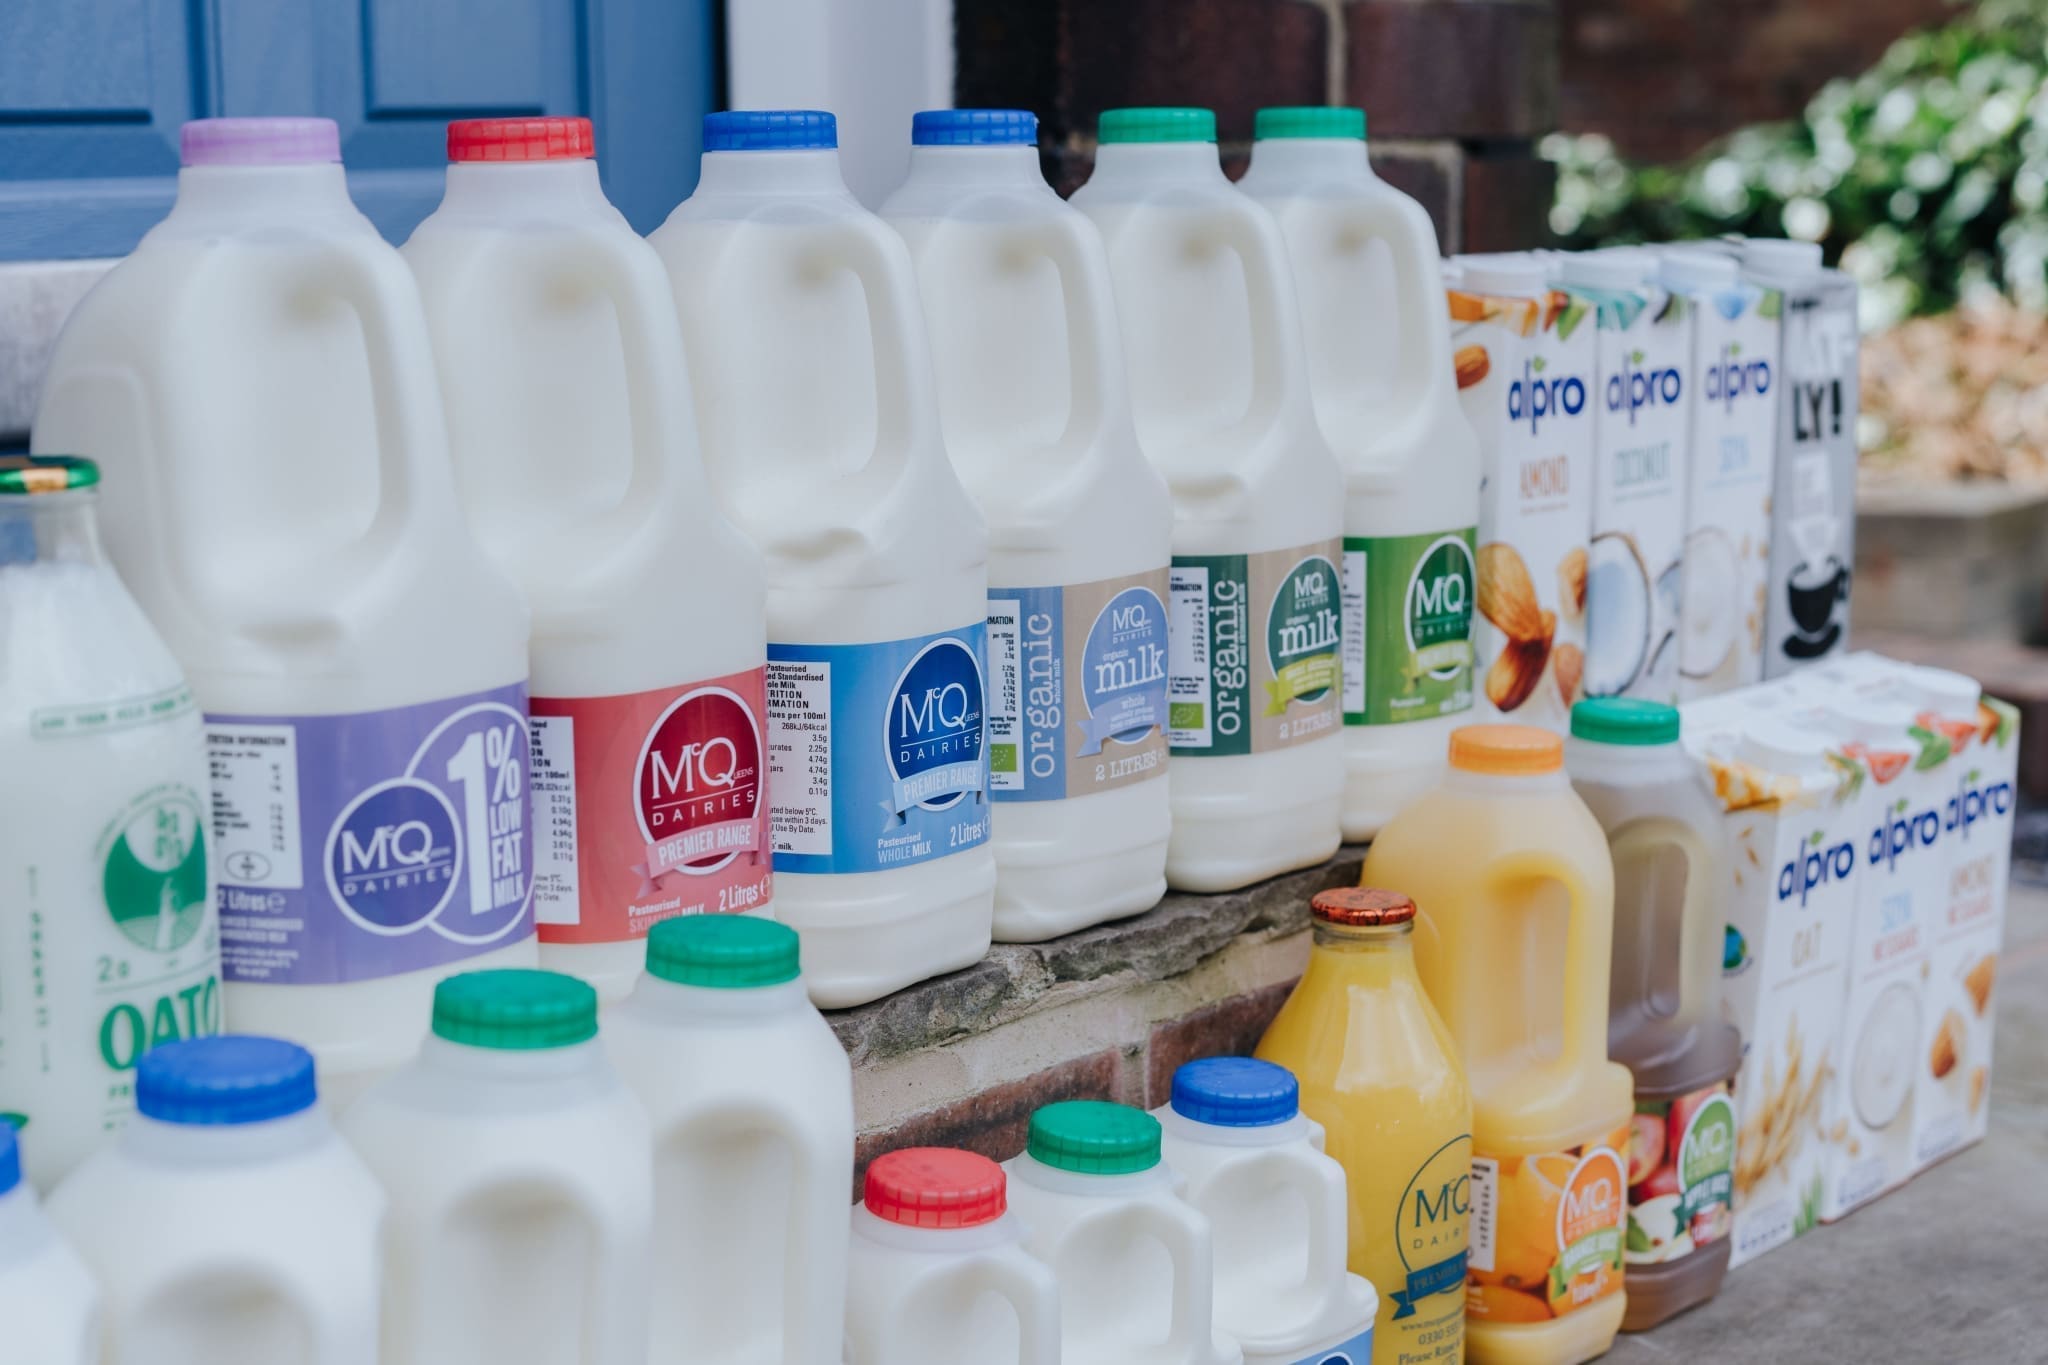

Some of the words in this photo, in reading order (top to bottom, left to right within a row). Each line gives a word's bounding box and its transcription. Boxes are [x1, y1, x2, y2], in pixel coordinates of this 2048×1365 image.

[1607, 353, 1681, 426] alpro
[1706, 345, 1770, 415] alpro
[1508, 359, 1586, 435] alpro
[1793, 379, 1842, 442] LY!
[1278, 608, 1339, 658] milk
[1095, 642, 1166, 694] milk
[1102, 648, 1129, 662] organic
[1209, 580, 1246, 735] organic
[767, 681, 778, 689] ole
[780, 681, 796, 689] Milk
[777, 672, 824, 682] Standardised
[1022, 613, 1061, 778] organic
[803, 712, 826, 720] 100ml
[808, 745, 828, 754] 2.25g
[812, 734, 828, 743] 3.5g
[901, 732, 981, 763] DAIRIES
[808, 756, 828, 764] 4.74g
[808, 767, 828, 775] 4.74g
[1095, 764, 1105, 783] 2
[1110, 750, 1157, 778] LITRES
[808, 788, 828, 797] 0.11g
[812, 777, 828, 786] 3.4g
[903, 771, 948, 802] PREMIER
[949, 766, 977, 789] RANGE
[447, 722, 523, 916] 1%
[490, 797, 523, 837] LOW
[652, 789, 755, 826] DAIRIES
[784, 807, 804, 815] below
[805, 817, 809, 825] 3
[810, 818, 828, 826] days.
[1946, 775, 2013, 840] alpro
[775, 824, 788, 832] Use
[788, 825, 798, 834] By
[878, 831, 921, 848] Pasteurised
[950, 826, 956, 847] 2
[958, 822, 982, 845] Litres
[1869, 806, 1939, 873] alpro
[492, 831, 524, 881] FAT
[659, 832, 714, 867] PREMIER
[717, 825, 752, 848] RANGE
[778, 843, 794, 851] milk.
[878, 845, 911, 863] WHOLE
[912, 840, 931, 858] MILK
[343, 864, 453, 897] DAIRIES
[1778, 838, 1854, 907] alpro
[628, 896, 681, 917] Pasteurised
[719, 889, 726, 913] 2
[729, 882, 759, 909] Litres
